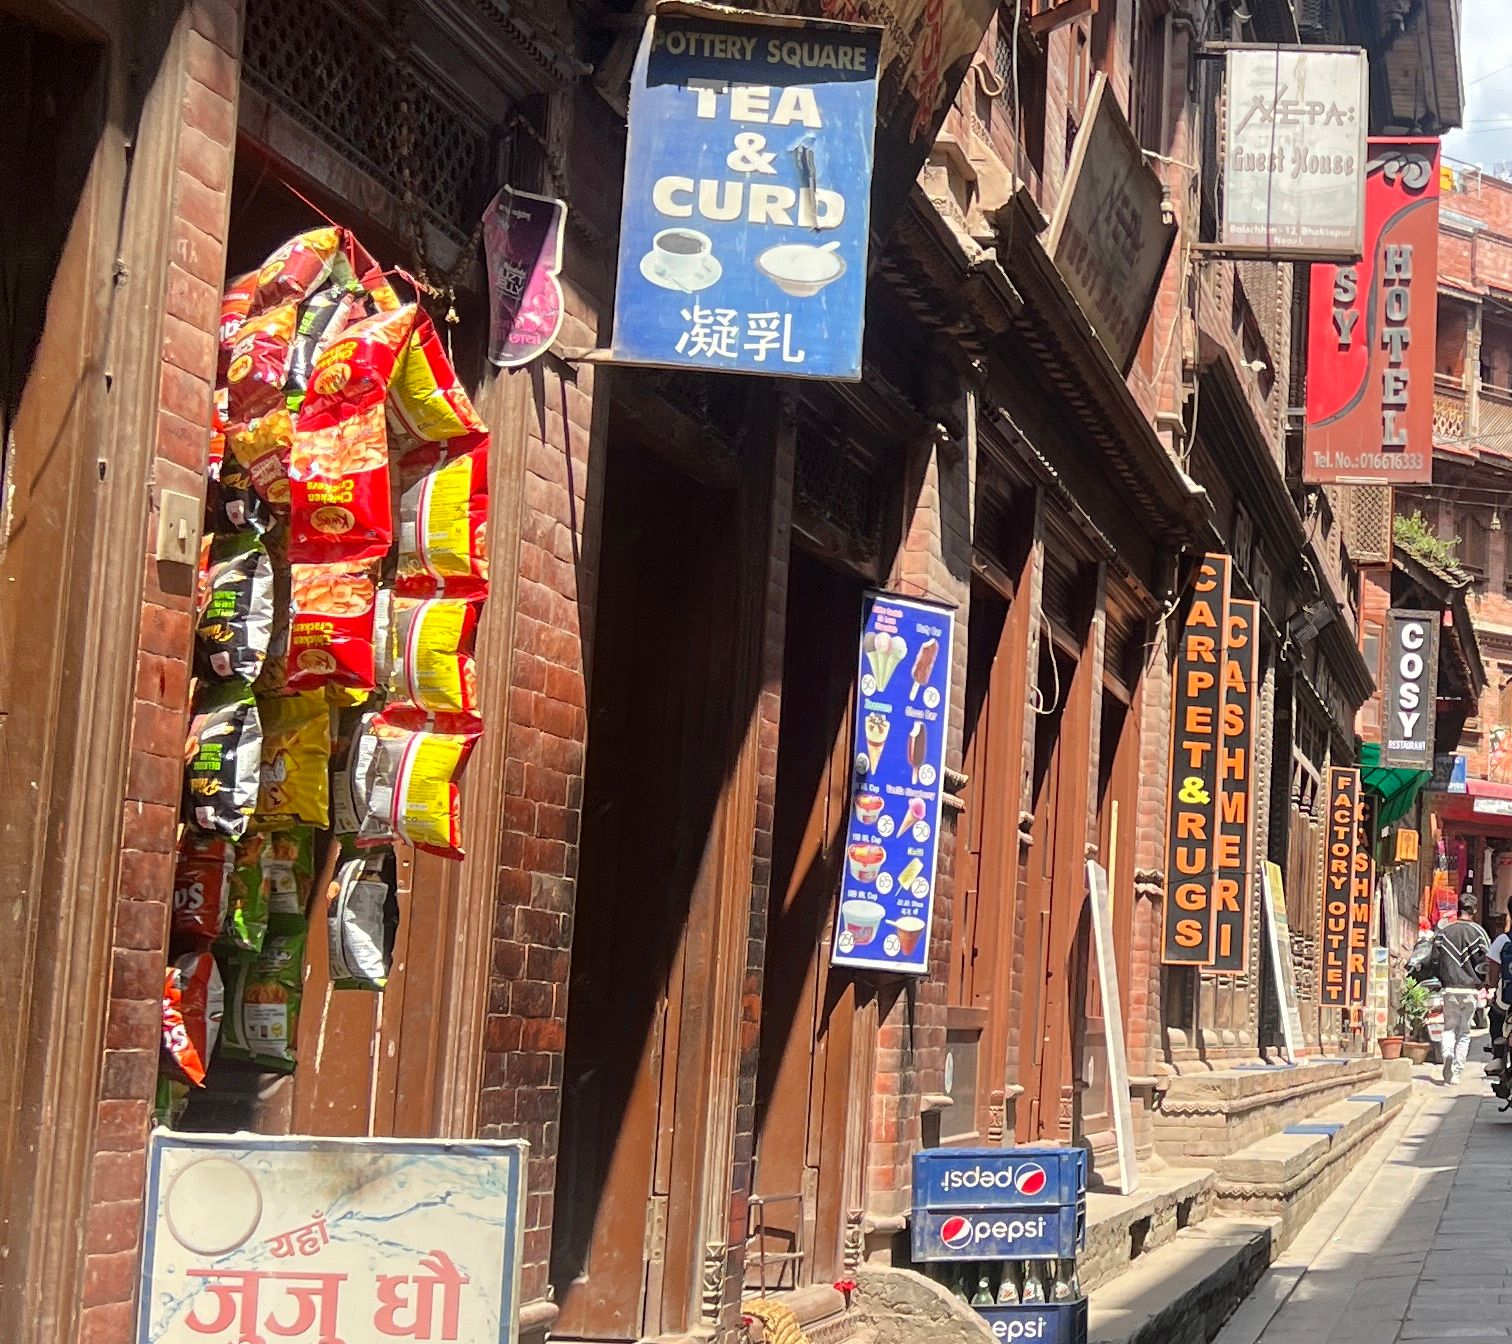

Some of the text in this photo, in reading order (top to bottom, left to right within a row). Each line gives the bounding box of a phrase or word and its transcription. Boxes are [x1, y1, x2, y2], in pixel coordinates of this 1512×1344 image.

[651, 29, 867, 72] POTTERY SQUARE
[687, 78, 823, 128] TEA
[726, 132, 777, 174] &
[1232, 146, 1354, 179] Guest House
[652, 176, 845, 230] CURD
[674, 305, 806, 363] 凝乳
[1382, 244, 1414, 446] HOTEL
[1398, 623, 1425, 738] COSY
[1175, 564, 1217, 948] CARPET & RUGS
[1216, 615, 1249, 958] CASHMERI
[1326, 776, 1352, 1000] FACTORY OUTLET
[941, 1166, 1013, 1191] pepsi
[264, 1209, 334, 1259] यहाँ
[975, 1216, 1047, 1242] pepsi
[373, 1249, 472, 1341] धौ
[989, 1317, 1047, 1343] epsi
